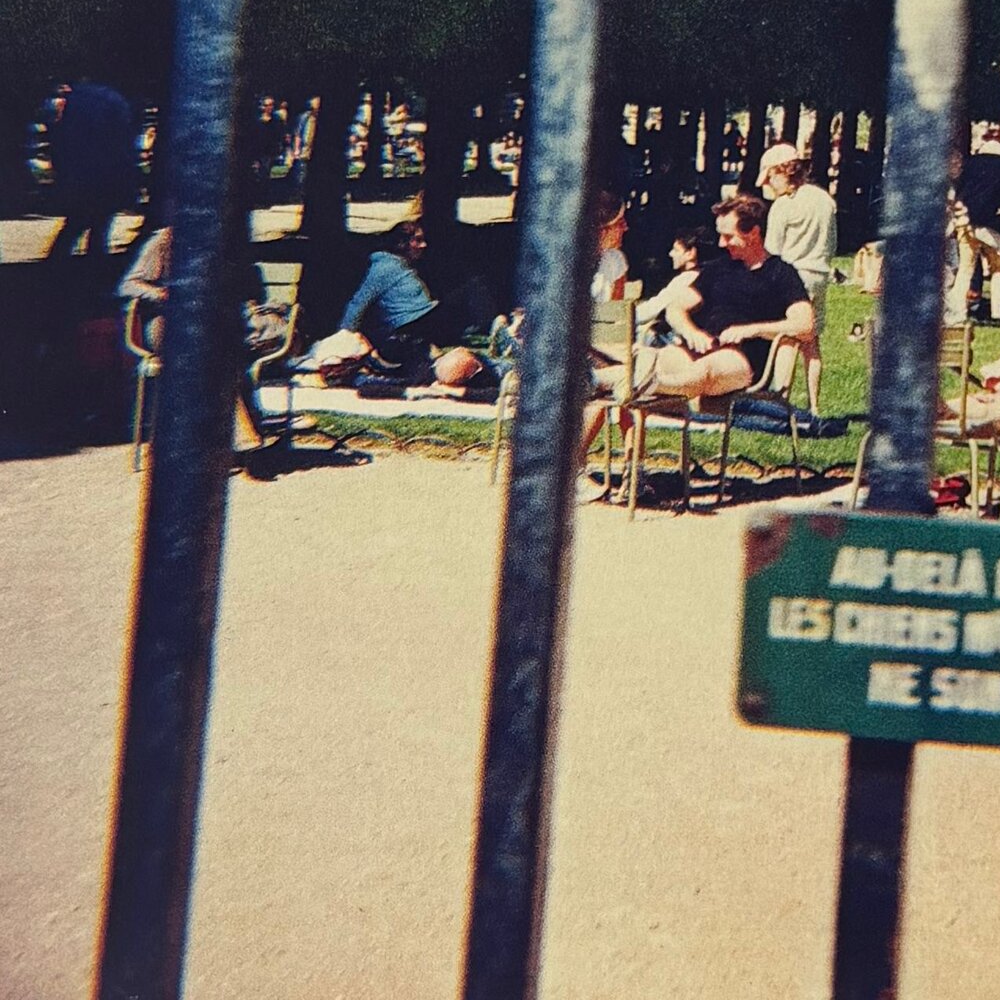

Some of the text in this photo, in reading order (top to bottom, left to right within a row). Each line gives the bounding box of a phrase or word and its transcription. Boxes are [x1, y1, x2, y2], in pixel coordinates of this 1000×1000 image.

[766, 596, 833, 641] LES
[832, 601, 959, 653] CHIENS
[866, 661, 923, 706] NE
